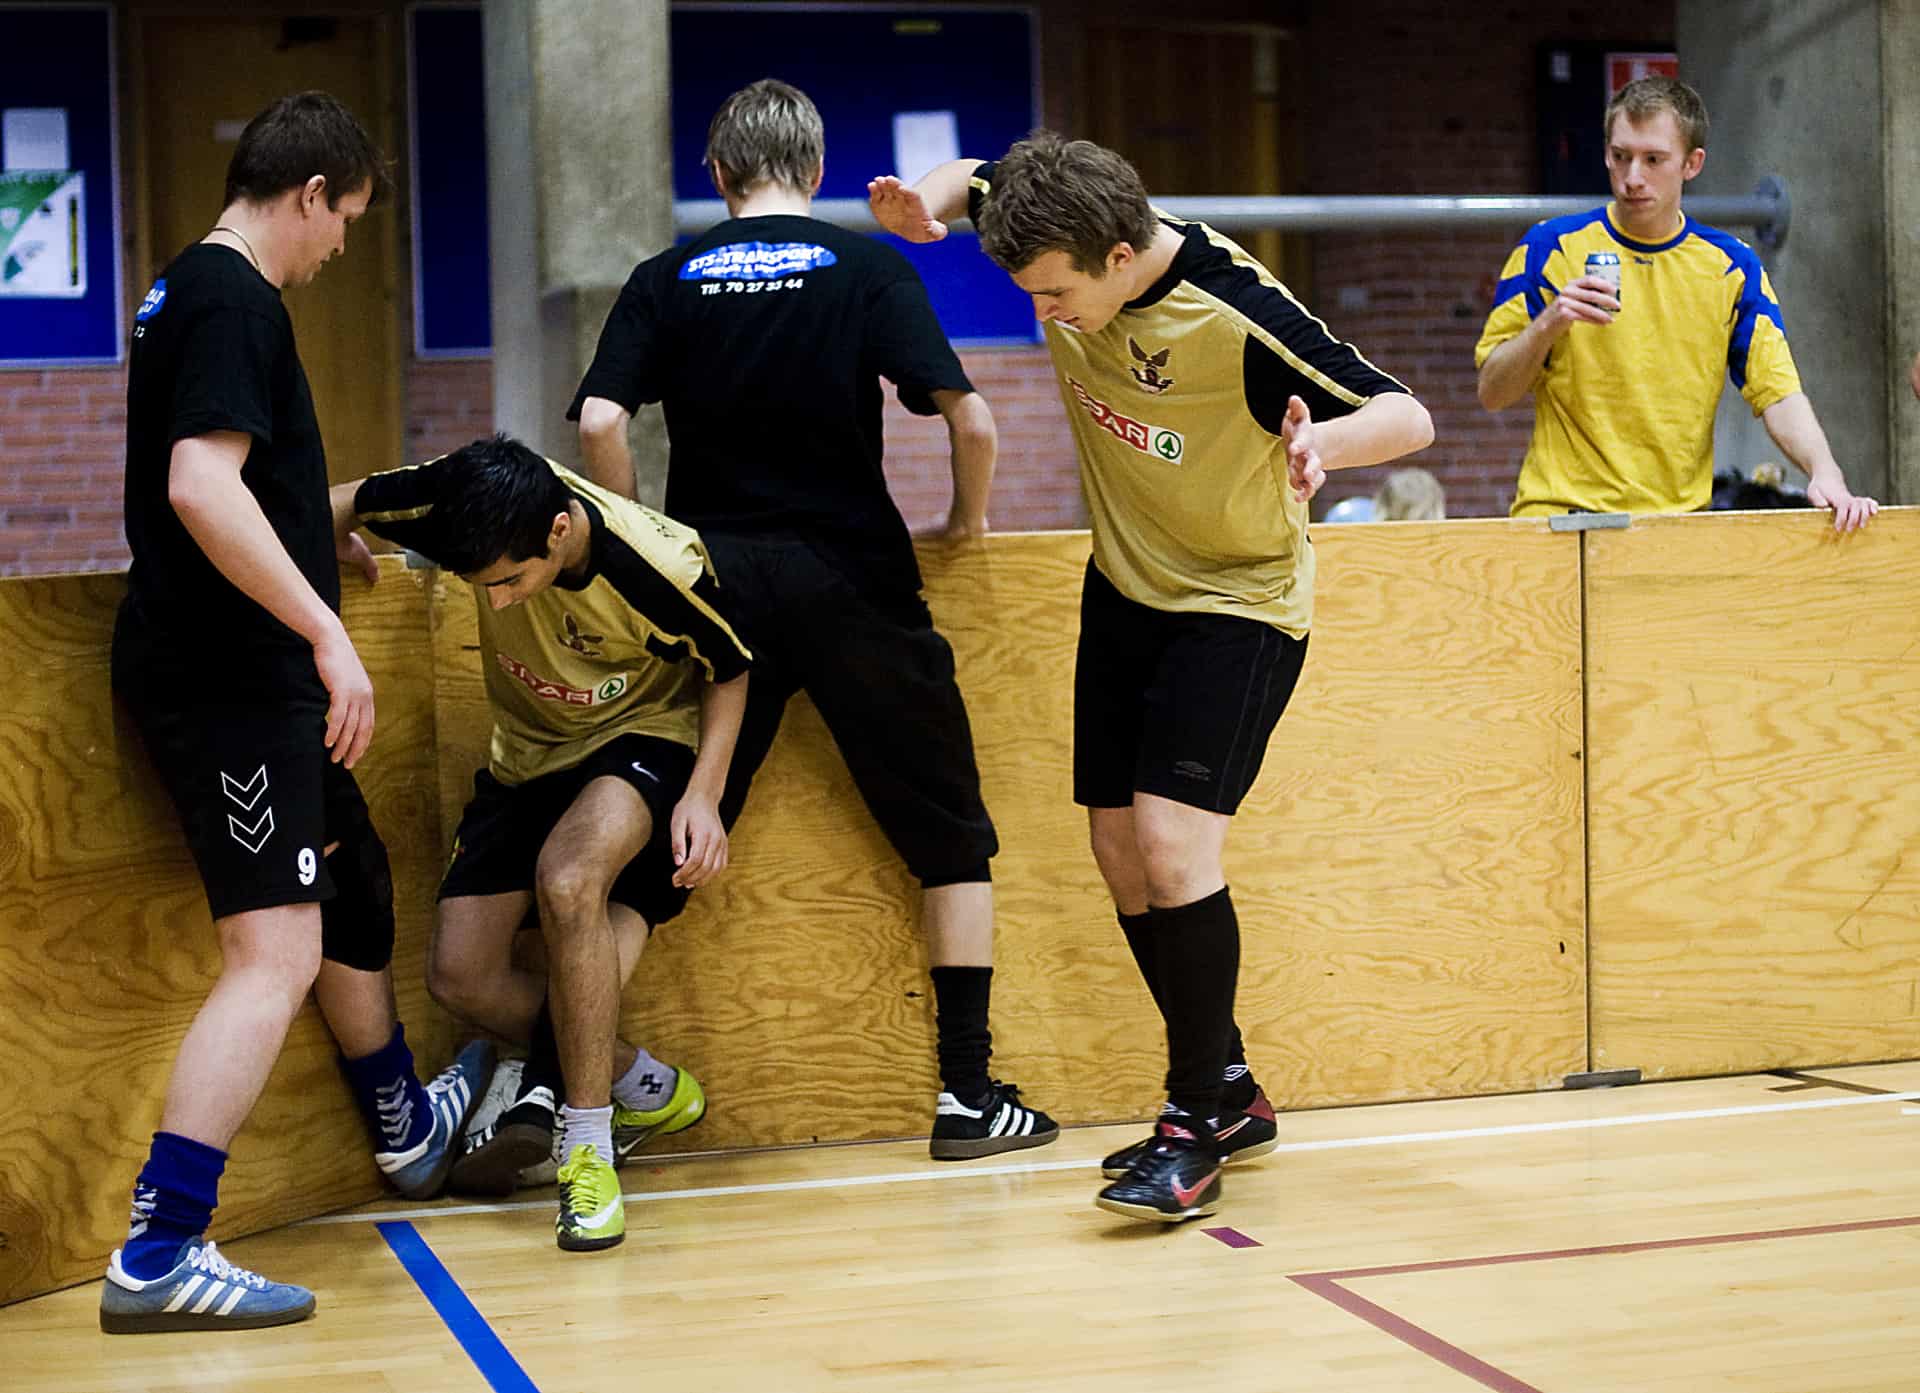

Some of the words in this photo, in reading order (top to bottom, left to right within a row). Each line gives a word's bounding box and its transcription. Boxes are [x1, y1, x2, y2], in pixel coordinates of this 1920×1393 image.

[687, 246, 825, 273] STS-TRANSPORT
[726, 282, 744, 293] 70
[746, 282, 765, 293] 27
[785, 279, 804, 289] 44
[298, 847, 317, 886] 9
